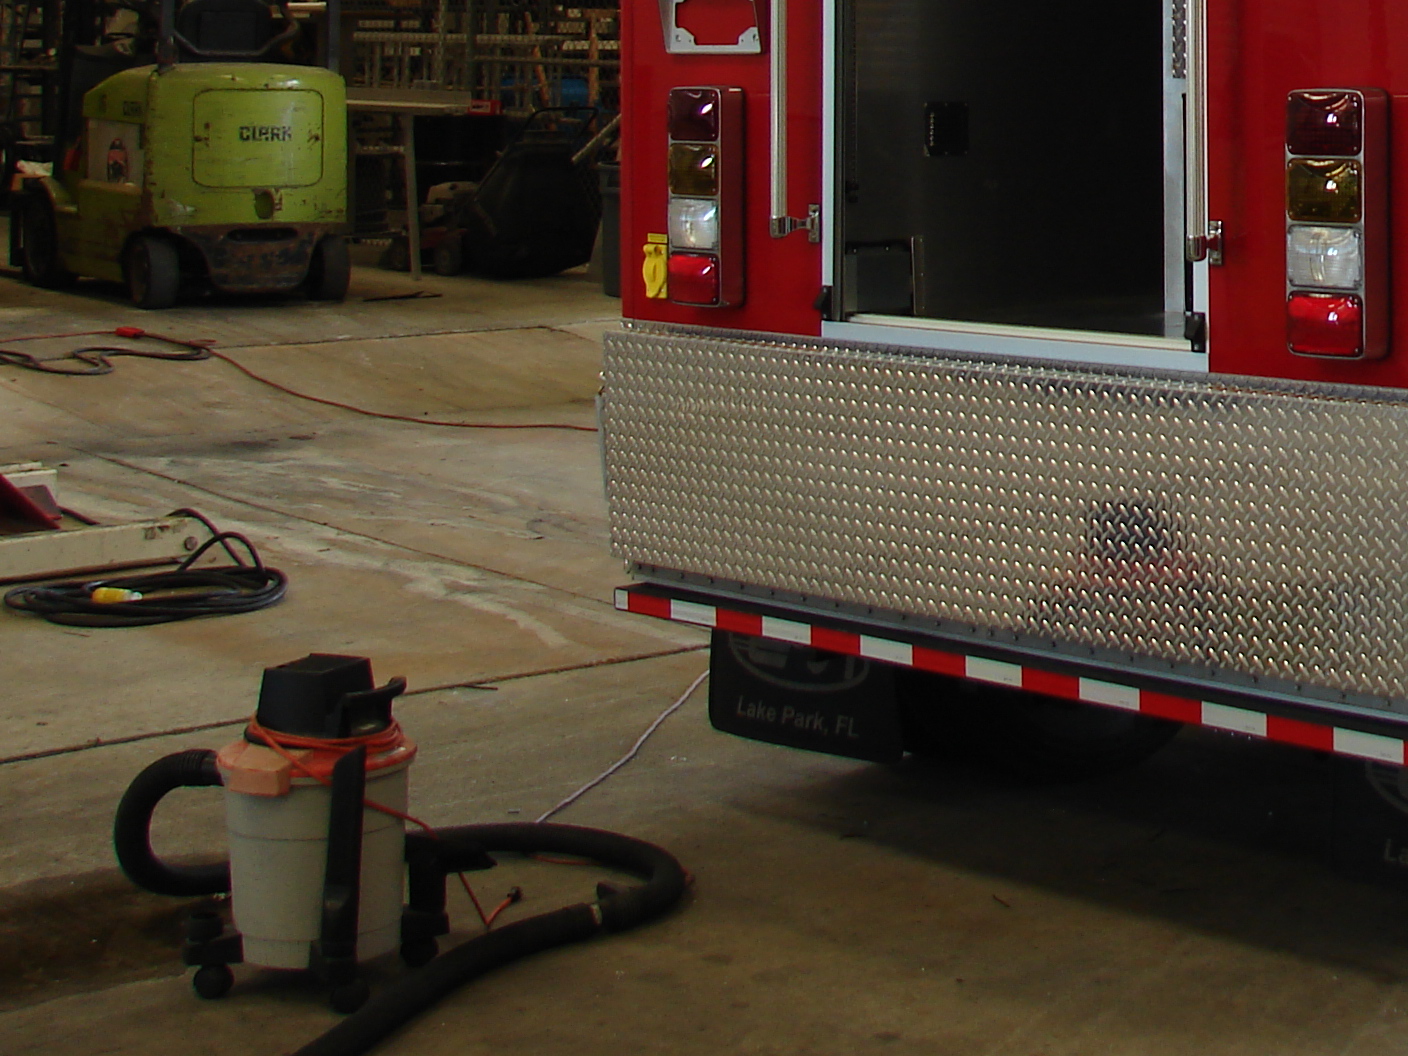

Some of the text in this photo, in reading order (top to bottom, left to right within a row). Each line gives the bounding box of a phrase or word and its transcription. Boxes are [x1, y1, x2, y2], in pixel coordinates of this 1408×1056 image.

[239, 125, 292, 141] CLARK
[737, 695, 859, 738] Lake Park, FL
